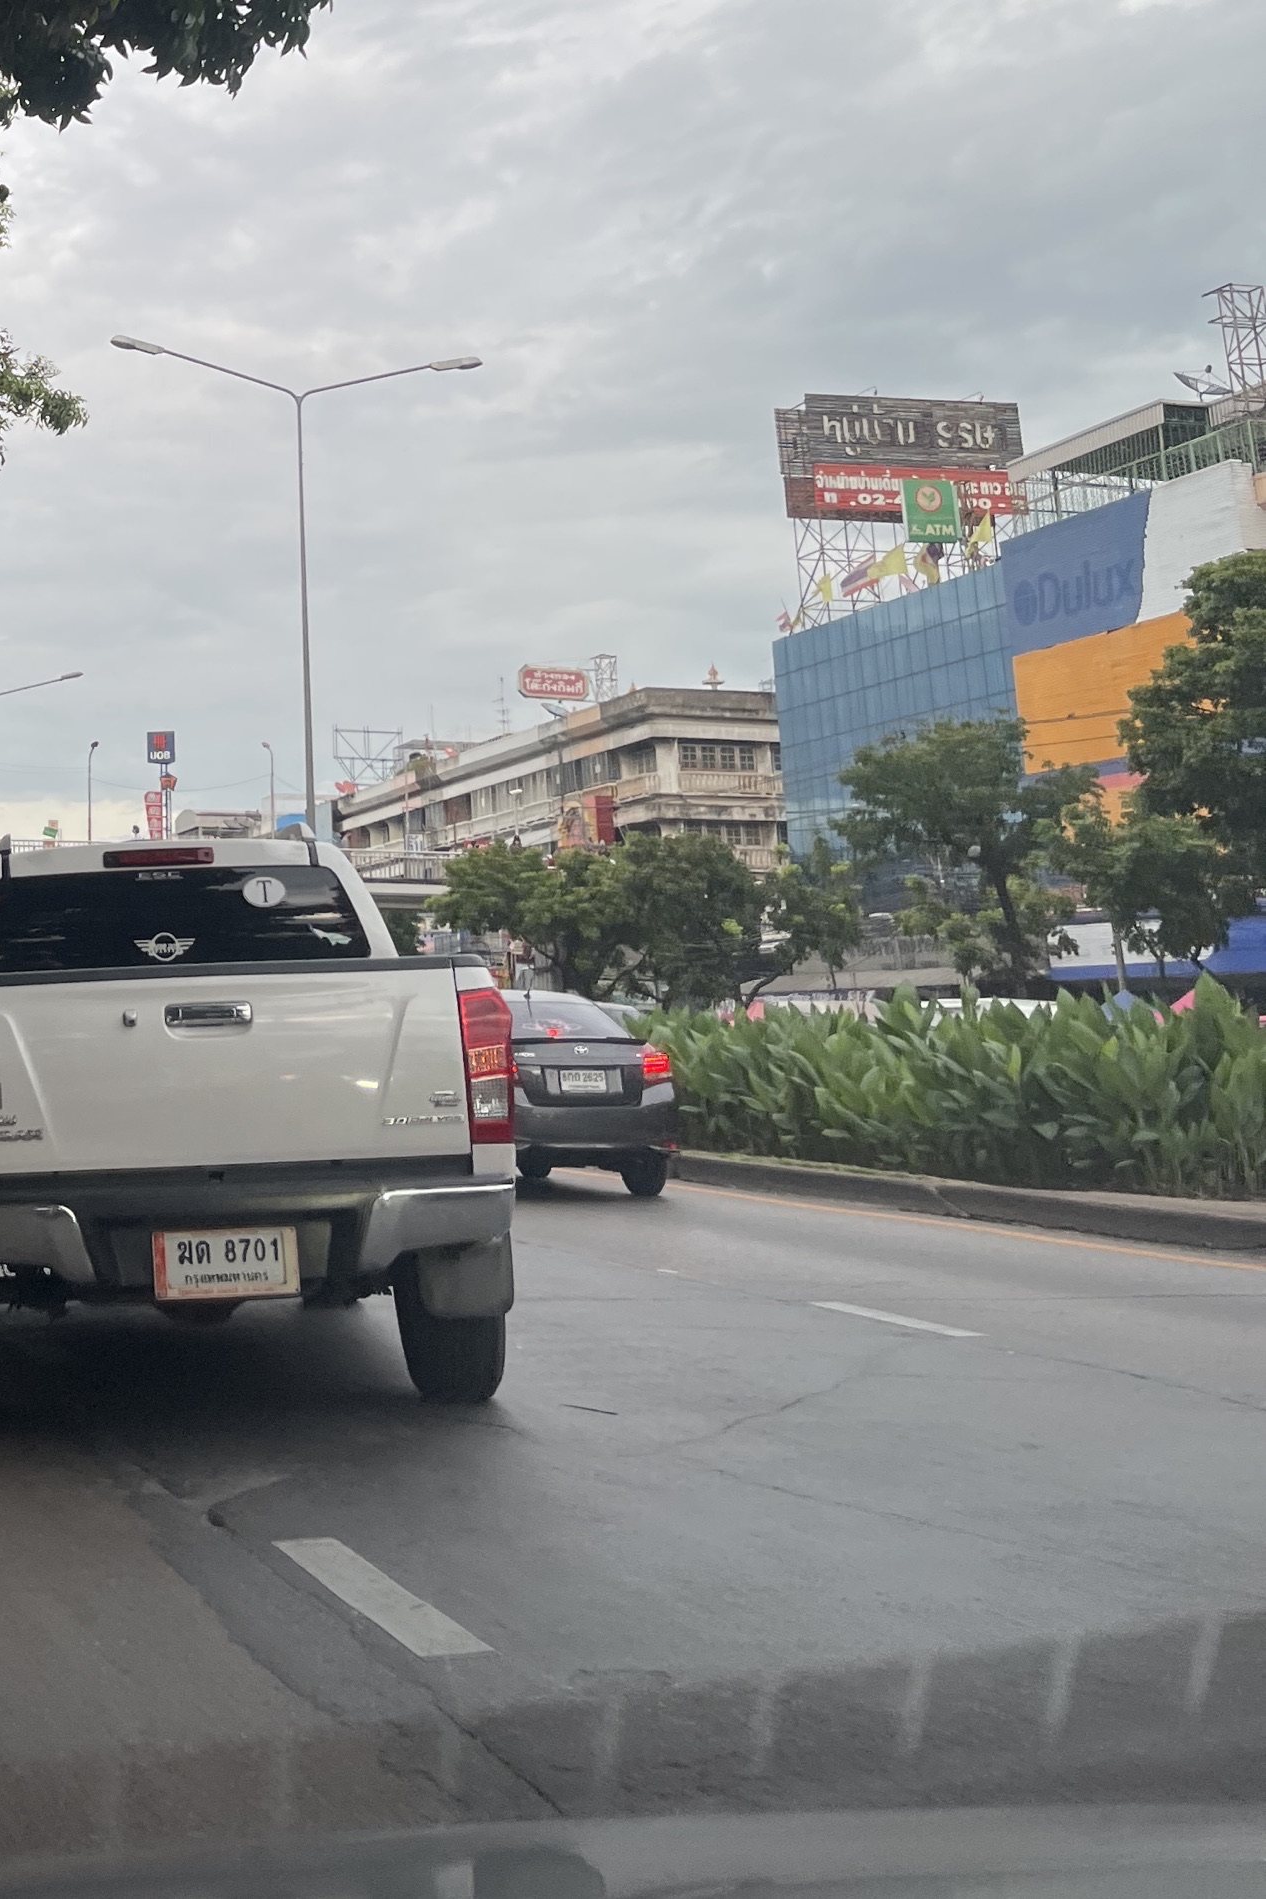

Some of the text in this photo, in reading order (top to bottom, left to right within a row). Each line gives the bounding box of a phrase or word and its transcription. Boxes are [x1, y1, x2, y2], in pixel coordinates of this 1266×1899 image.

[925, 523, 956, 536] ATM
[1037, 559, 1137, 622] Dulux
[149, 750, 171, 760] UOB
[255, 879, 273, 903] T
[225, 1237, 280, 1263] 8701
[185, 1271, 270, 1288] กรุงเทพมหานคร
